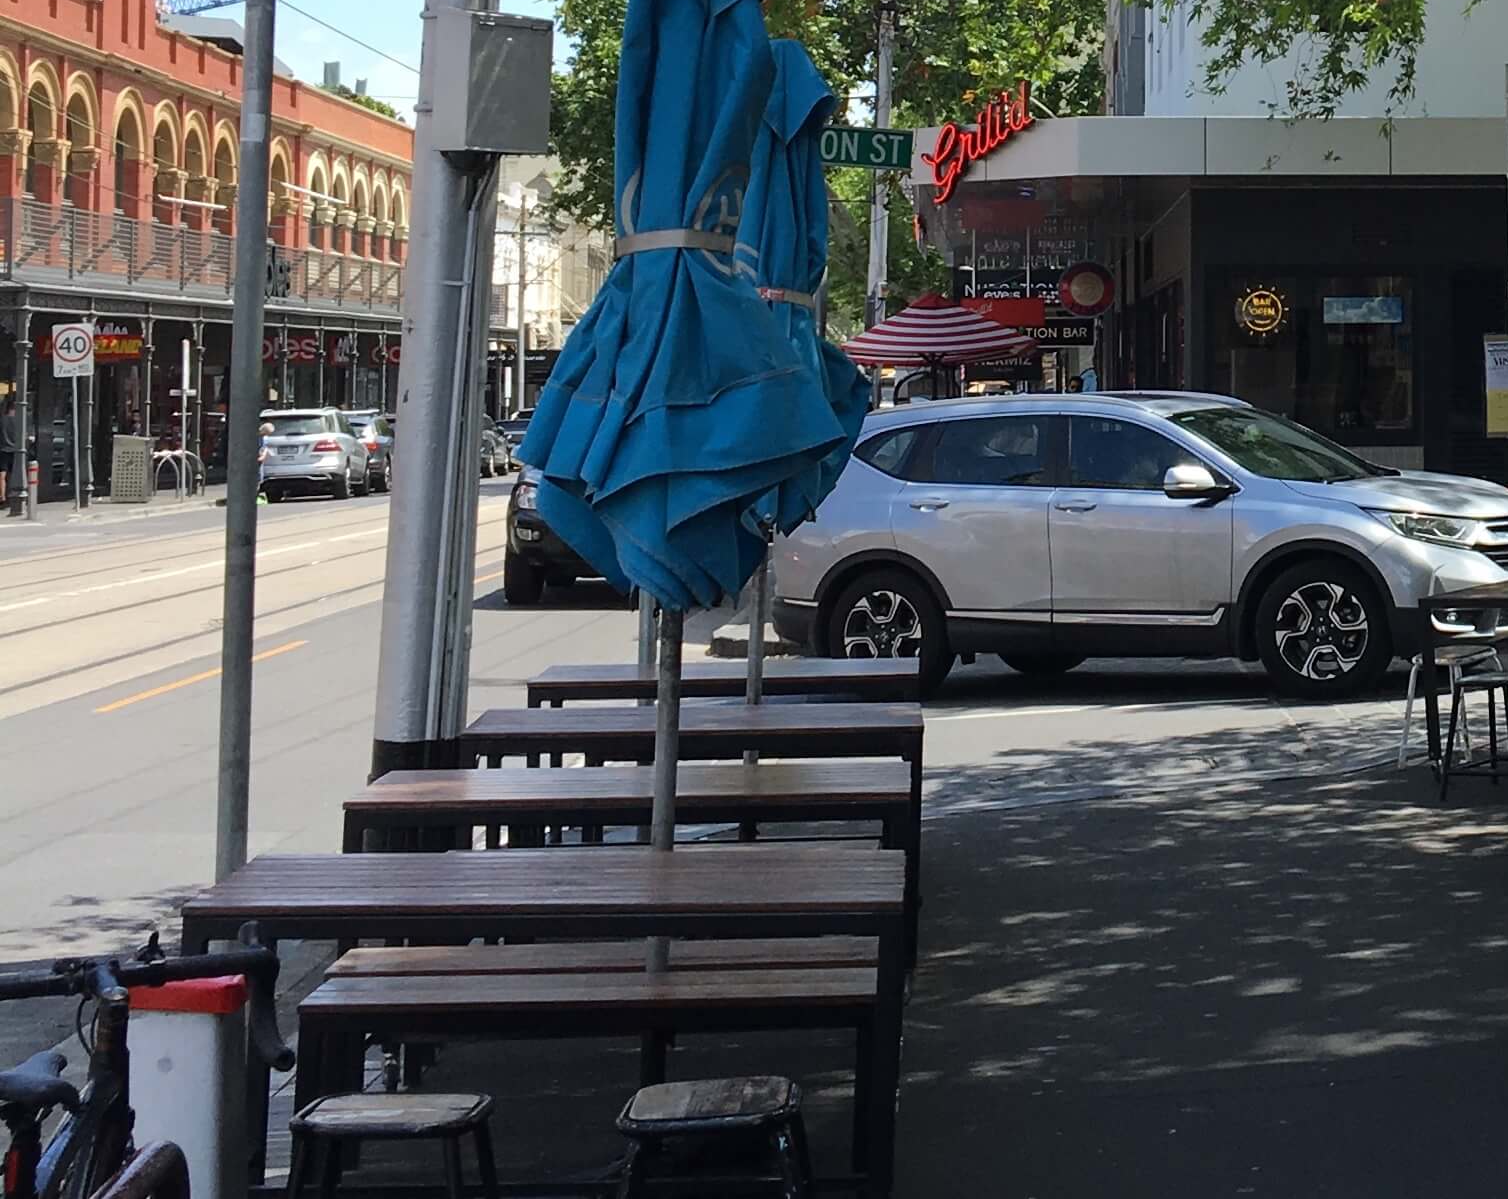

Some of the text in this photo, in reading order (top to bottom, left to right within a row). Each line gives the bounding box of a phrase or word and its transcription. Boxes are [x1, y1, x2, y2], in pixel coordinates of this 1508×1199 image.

[869, 131, 904, 164] ST
[1063, 327, 1087, 338] BAR
[59, 336, 86, 353] 40
